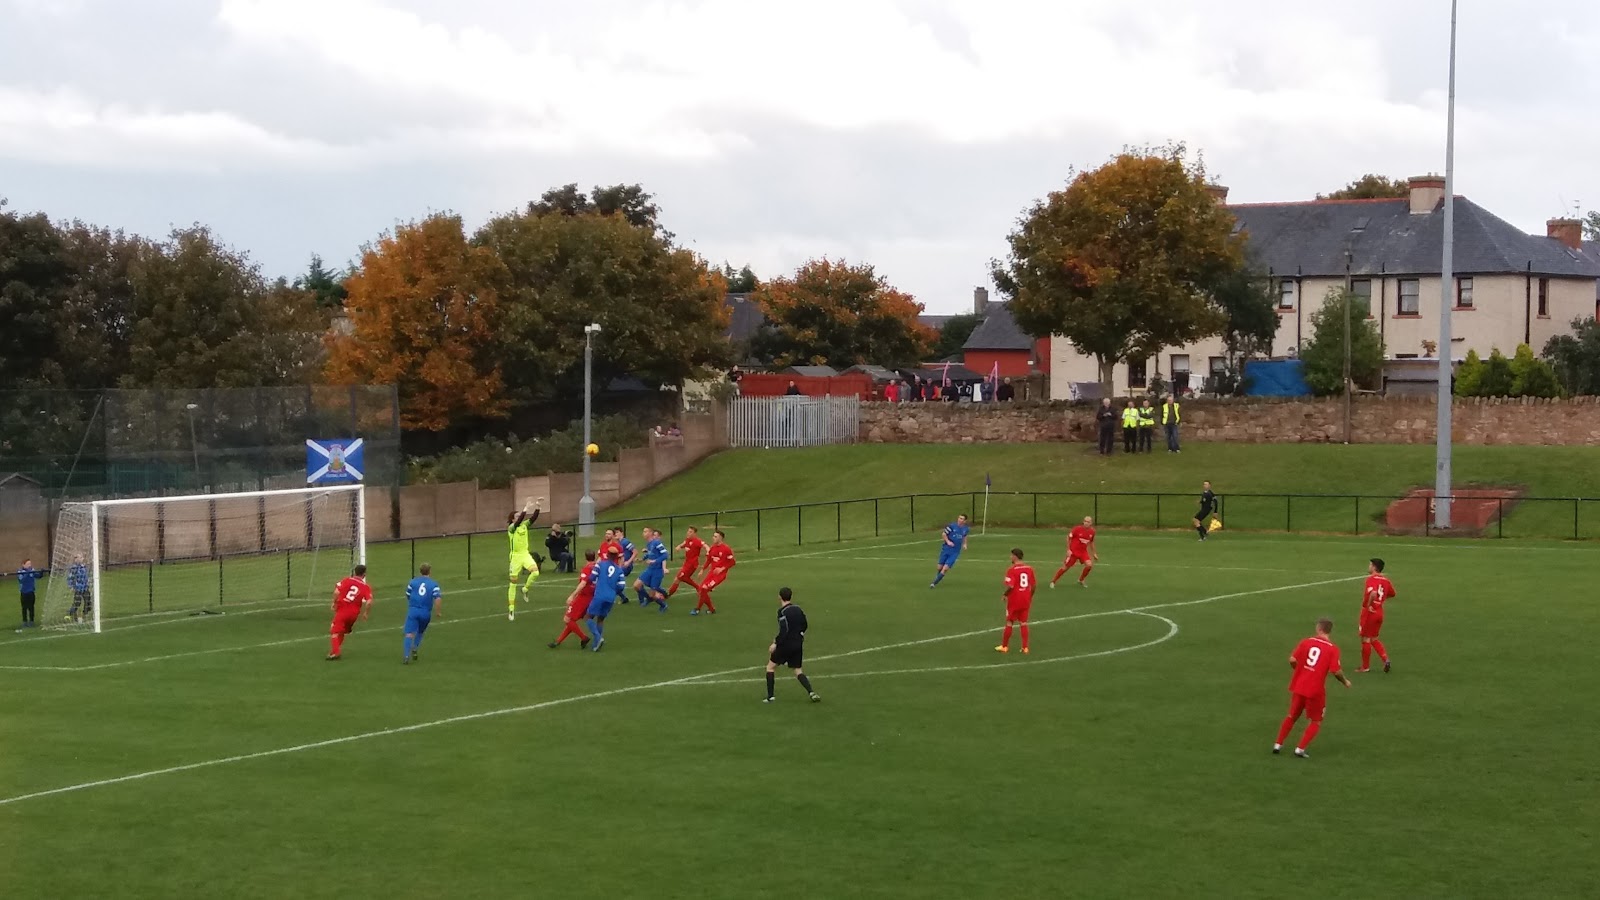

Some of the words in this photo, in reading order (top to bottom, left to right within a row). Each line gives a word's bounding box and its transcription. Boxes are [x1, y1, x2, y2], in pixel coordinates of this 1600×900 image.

[607, 565, 616, 577] 9
[1019, 572, 1029, 588] 8
[345, 585, 359, 601] 2
[418, 582, 427, 596] 6
[1306, 646, 1321, 667] 9
